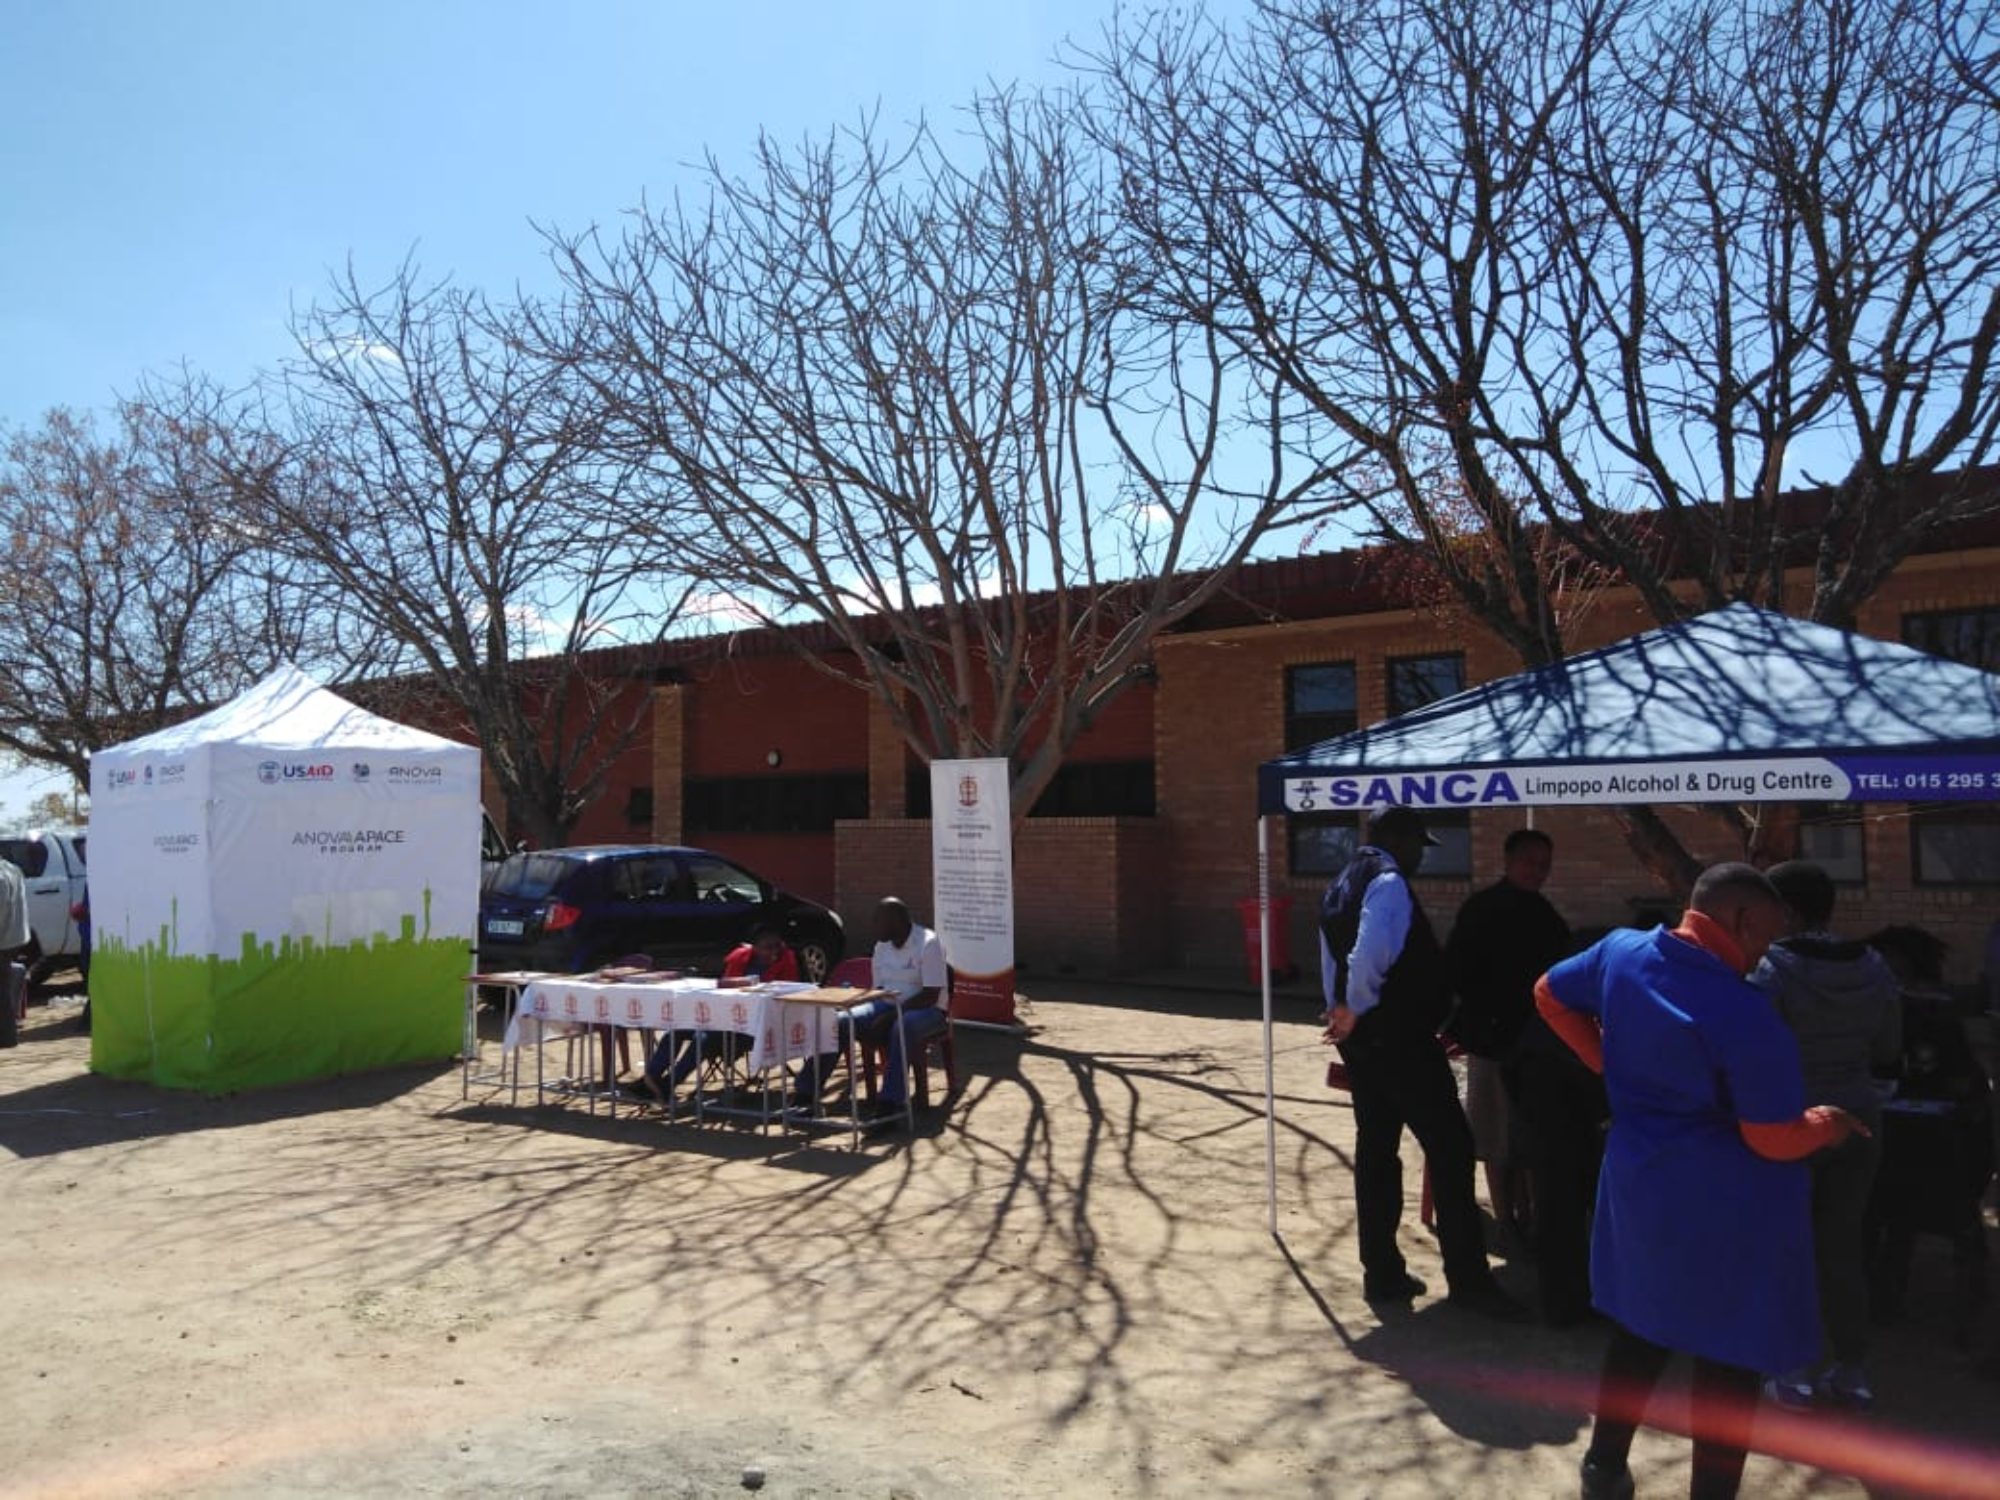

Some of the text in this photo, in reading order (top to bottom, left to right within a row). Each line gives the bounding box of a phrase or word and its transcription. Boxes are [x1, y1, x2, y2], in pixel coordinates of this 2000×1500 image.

[283, 764, 334, 778] USAID
[388, 766, 442, 778] ANOVA
[1857, 774, 1899, 788] TEL:
[1905, 774, 1942, 788] 015
[1947, 773, 1985, 788] 295
[1329, 771, 1833, 806] SANCA Limpopo Alcohol & Drug Centre
